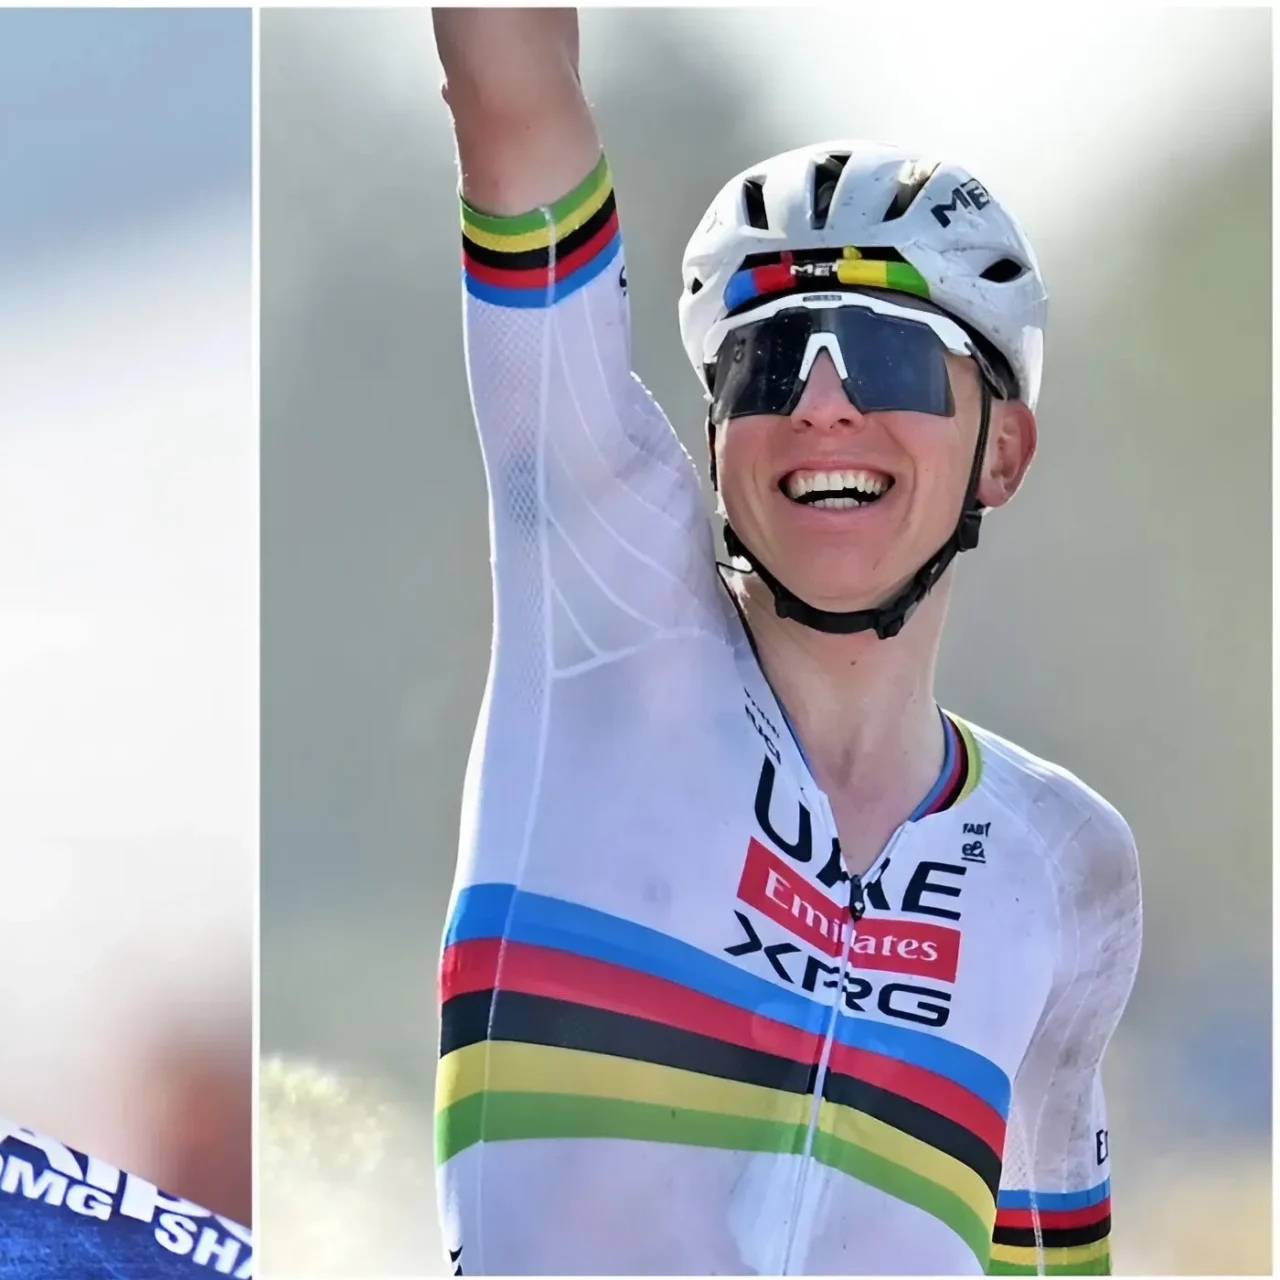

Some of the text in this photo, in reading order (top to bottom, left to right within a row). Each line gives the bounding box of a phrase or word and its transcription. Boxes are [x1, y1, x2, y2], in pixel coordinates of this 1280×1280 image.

[930, 177, 991, 229] ME
[753, 753, 968, 921] UAE
[723, 909, 953, 1028] XRG
